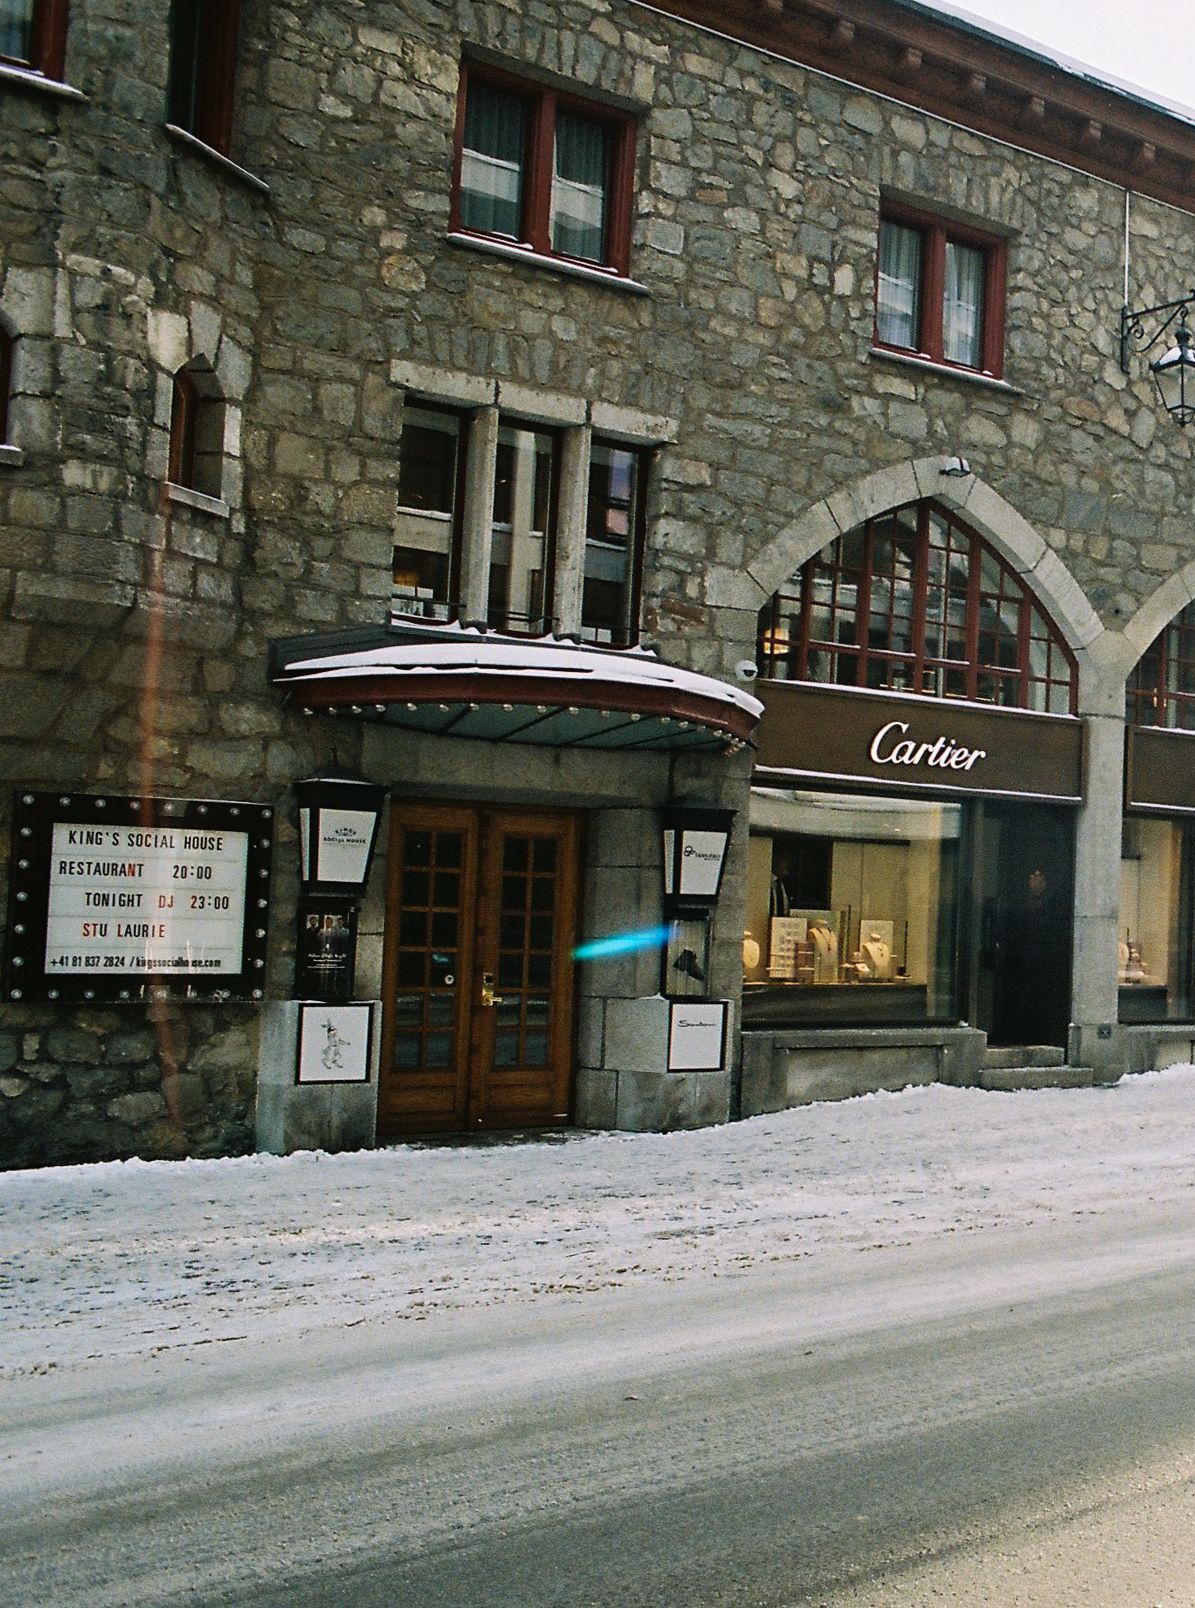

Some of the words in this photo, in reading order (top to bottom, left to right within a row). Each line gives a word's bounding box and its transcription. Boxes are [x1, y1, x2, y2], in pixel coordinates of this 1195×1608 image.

[870, 721, 987, 771] Cartier
[68, 830, 120, 846] KING'S
[128, 833, 175, 848] SOCIAL
[183, 836, 223, 851] HOUSE
[59, 860, 145, 877] RESTAURANT
[172, 865, 212, 880] 20:00
[85, 892, 143, 907] TONIGHT
[158, 895, 174, 908] DJ
[190, 896, 229, 910] 23:00
[82, 923, 108, 937] STU
[117, 924, 166, 938] LAURIE
[50, 955, 69, 967] +41
[71, 955, 82, 967] 81
[84, 955, 100, 967] 837
[103, 956, 125, 967] 2824
